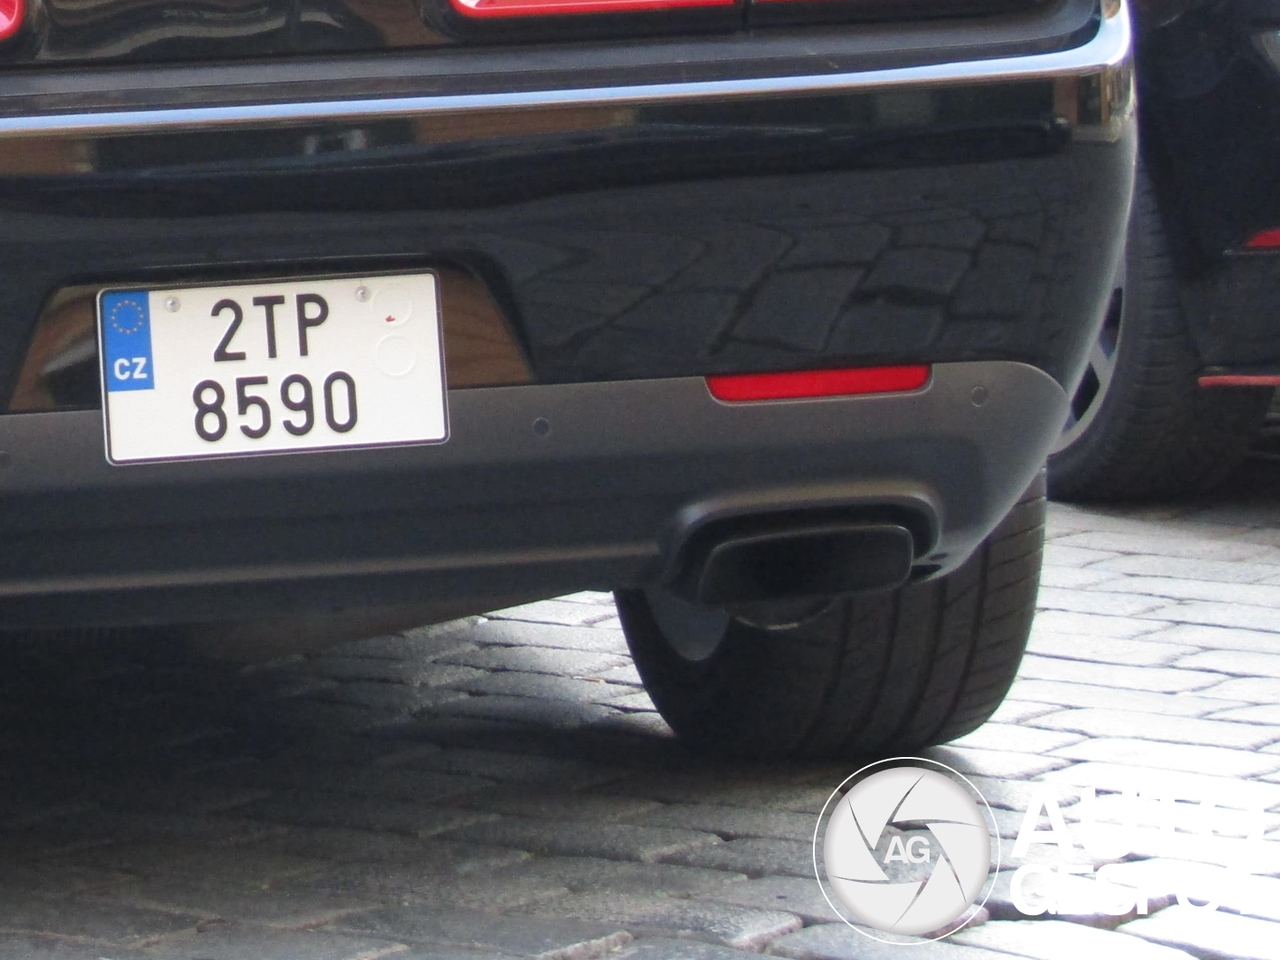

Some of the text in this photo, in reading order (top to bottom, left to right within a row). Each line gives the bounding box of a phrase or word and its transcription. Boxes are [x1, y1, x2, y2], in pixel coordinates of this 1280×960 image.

[210, 293, 330, 362] 2TP
[114, 356, 148, 380] CZ
[192, 370, 359, 442] 8590
